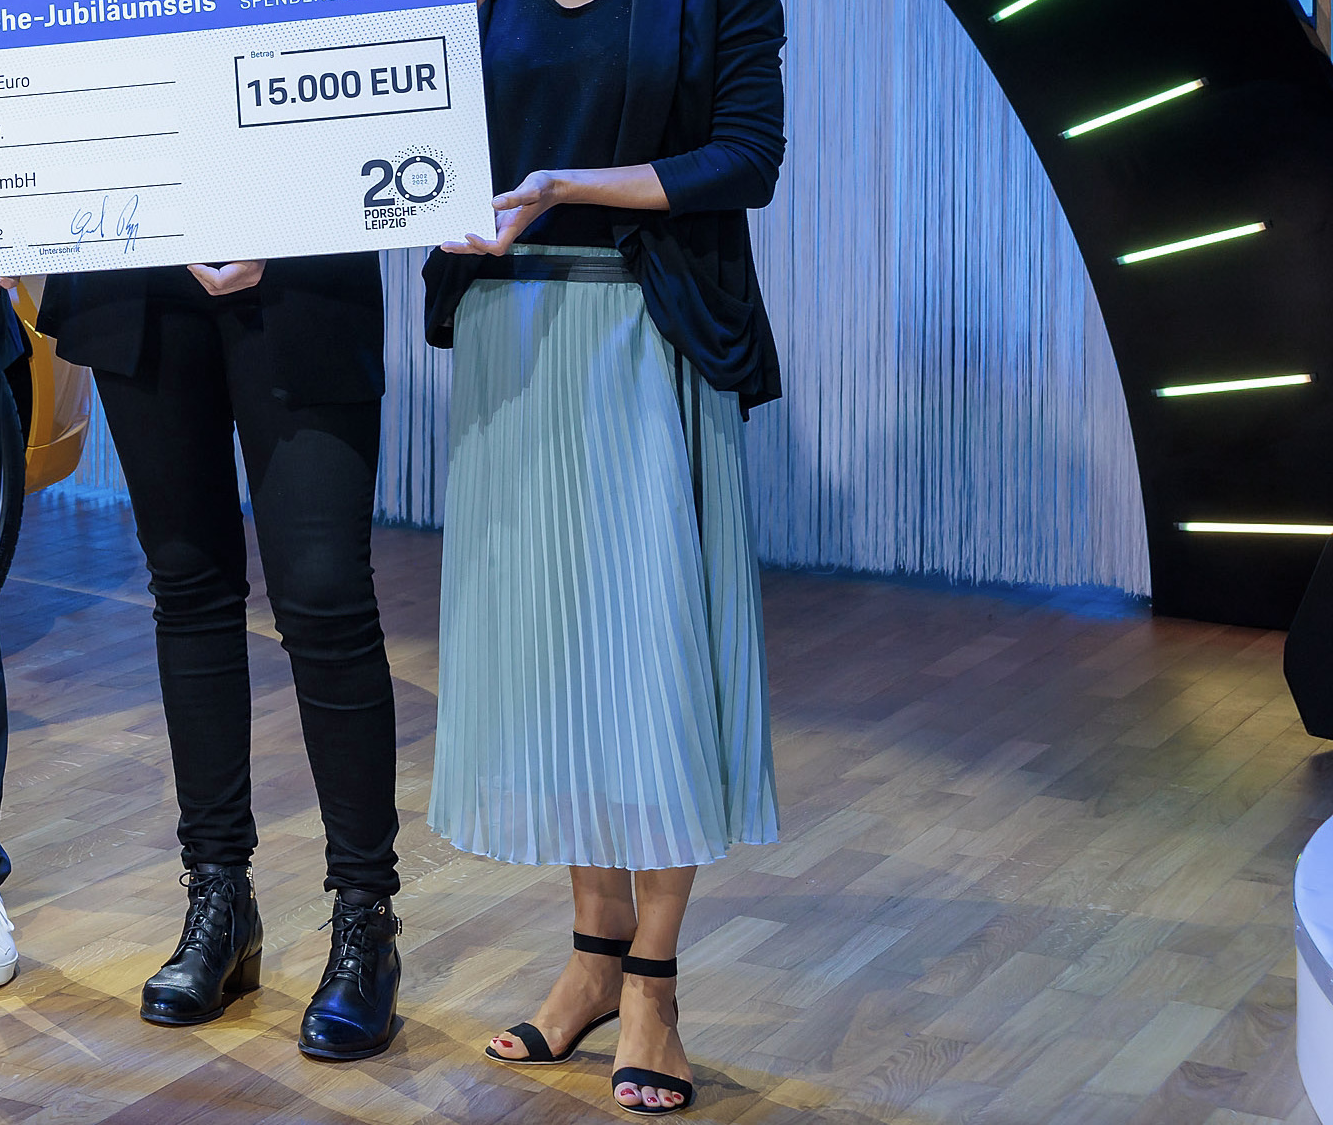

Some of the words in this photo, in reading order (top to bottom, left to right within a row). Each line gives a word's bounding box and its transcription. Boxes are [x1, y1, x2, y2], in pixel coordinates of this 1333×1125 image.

[250, 49, 275, 59] Betrag
[247, 70, 361, 107] 15.000
[370, 63, 438, 96] EUR
[361, 155, 445, 208] 20
[364, 206, 417, 219] PORSCHE
[365, 218, 407, 230] LEIPZIG
